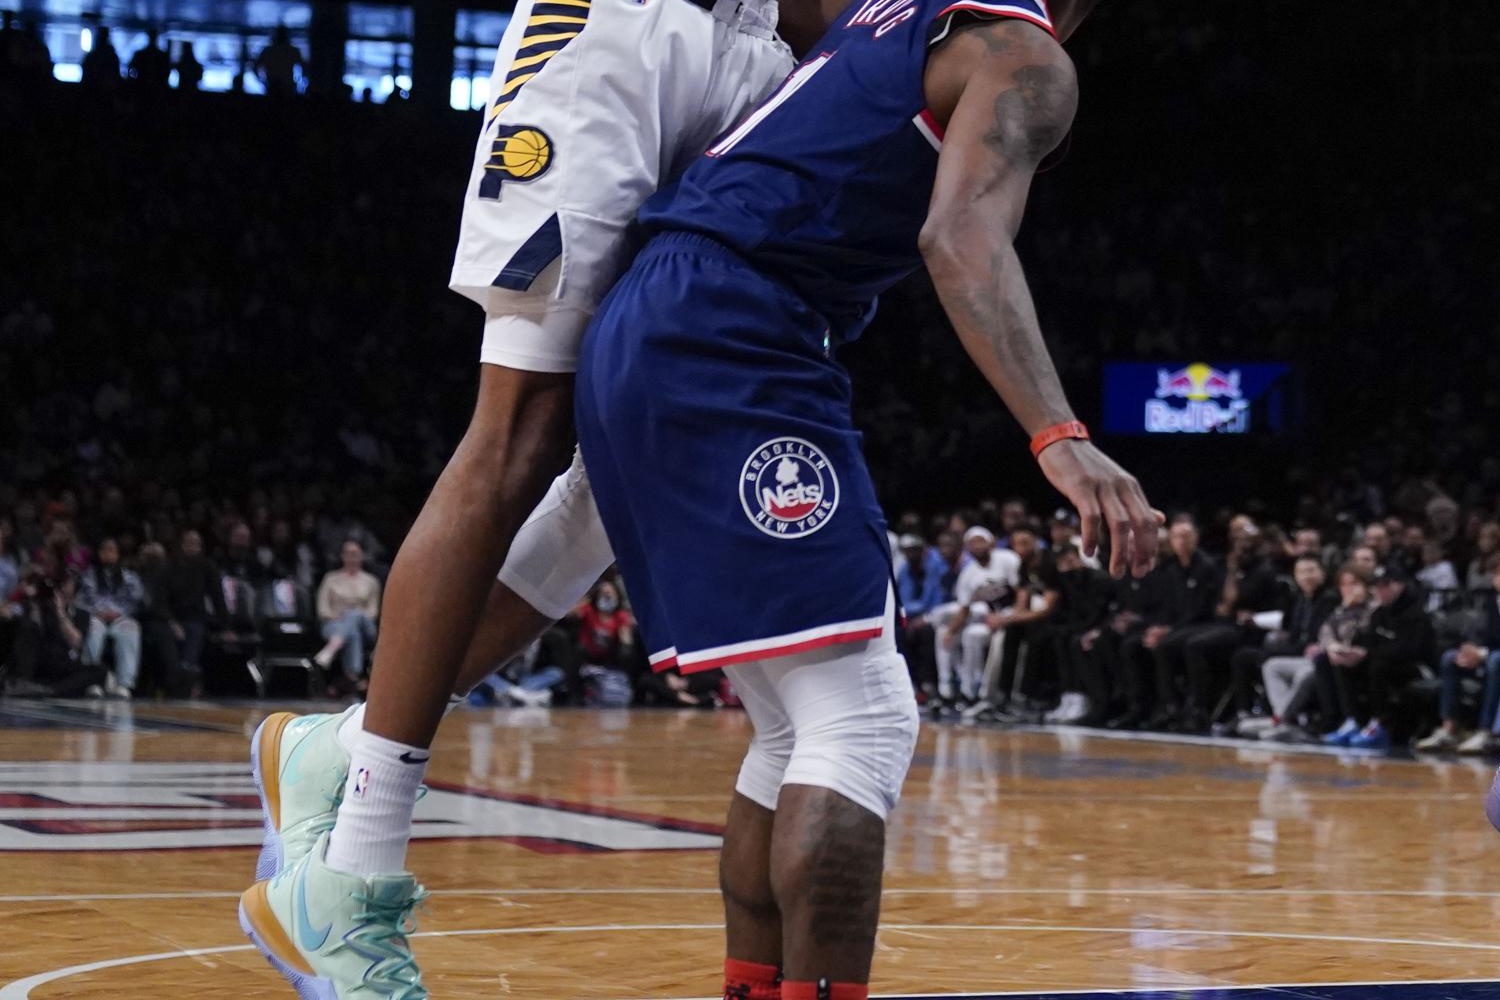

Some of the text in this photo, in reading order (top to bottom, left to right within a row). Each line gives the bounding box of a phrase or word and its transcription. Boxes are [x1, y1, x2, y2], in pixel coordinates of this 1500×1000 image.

[745, 442, 826, 481] BROOKLYN
[761, 482, 821, 511] Nets
[755, 499, 832, 534] NEW YORK
